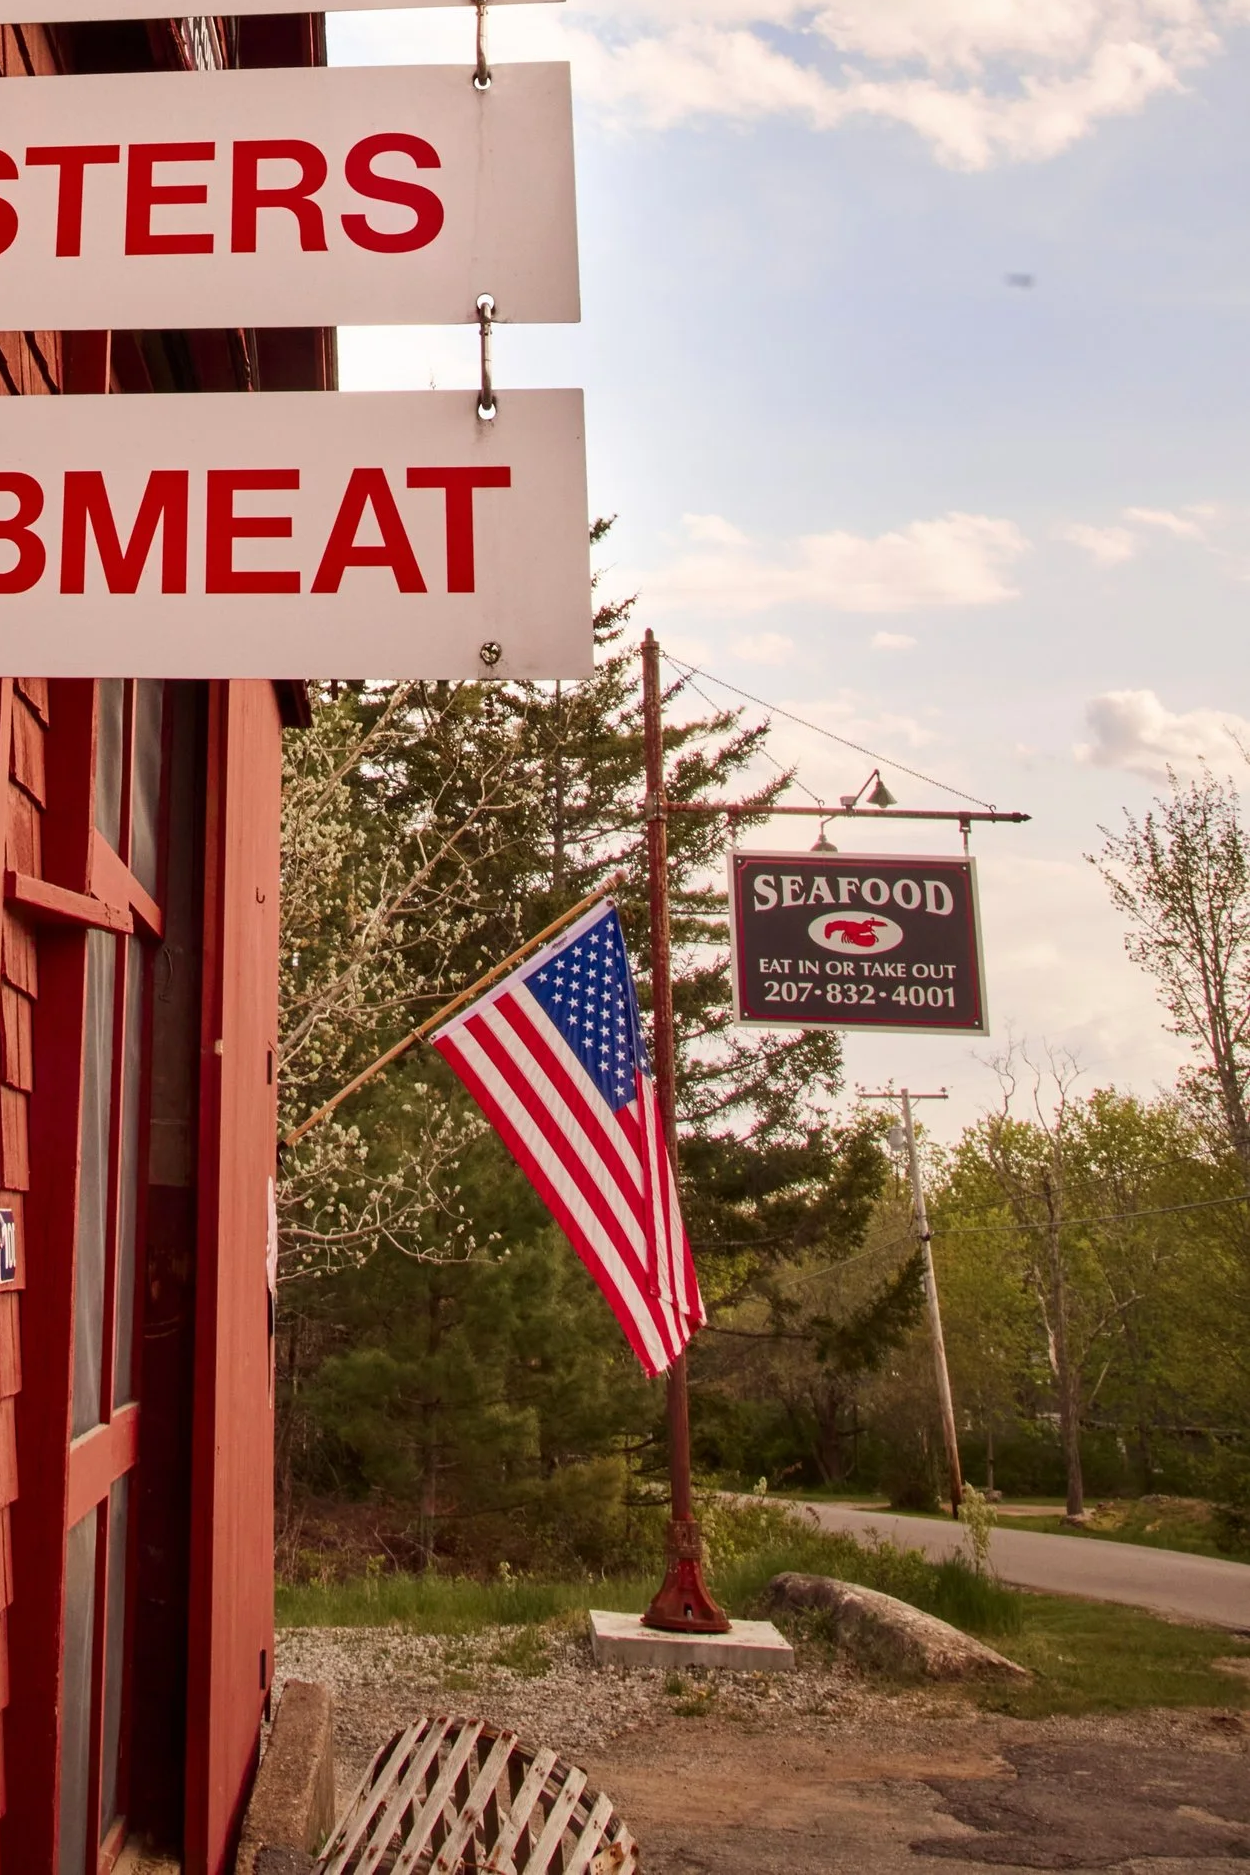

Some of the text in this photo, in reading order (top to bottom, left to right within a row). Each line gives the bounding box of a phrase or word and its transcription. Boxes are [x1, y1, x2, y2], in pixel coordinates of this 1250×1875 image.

[753, 874, 954, 916] SEAFOOD
[759, 958, 956, 979] EAT IN OR TAKE OUT
